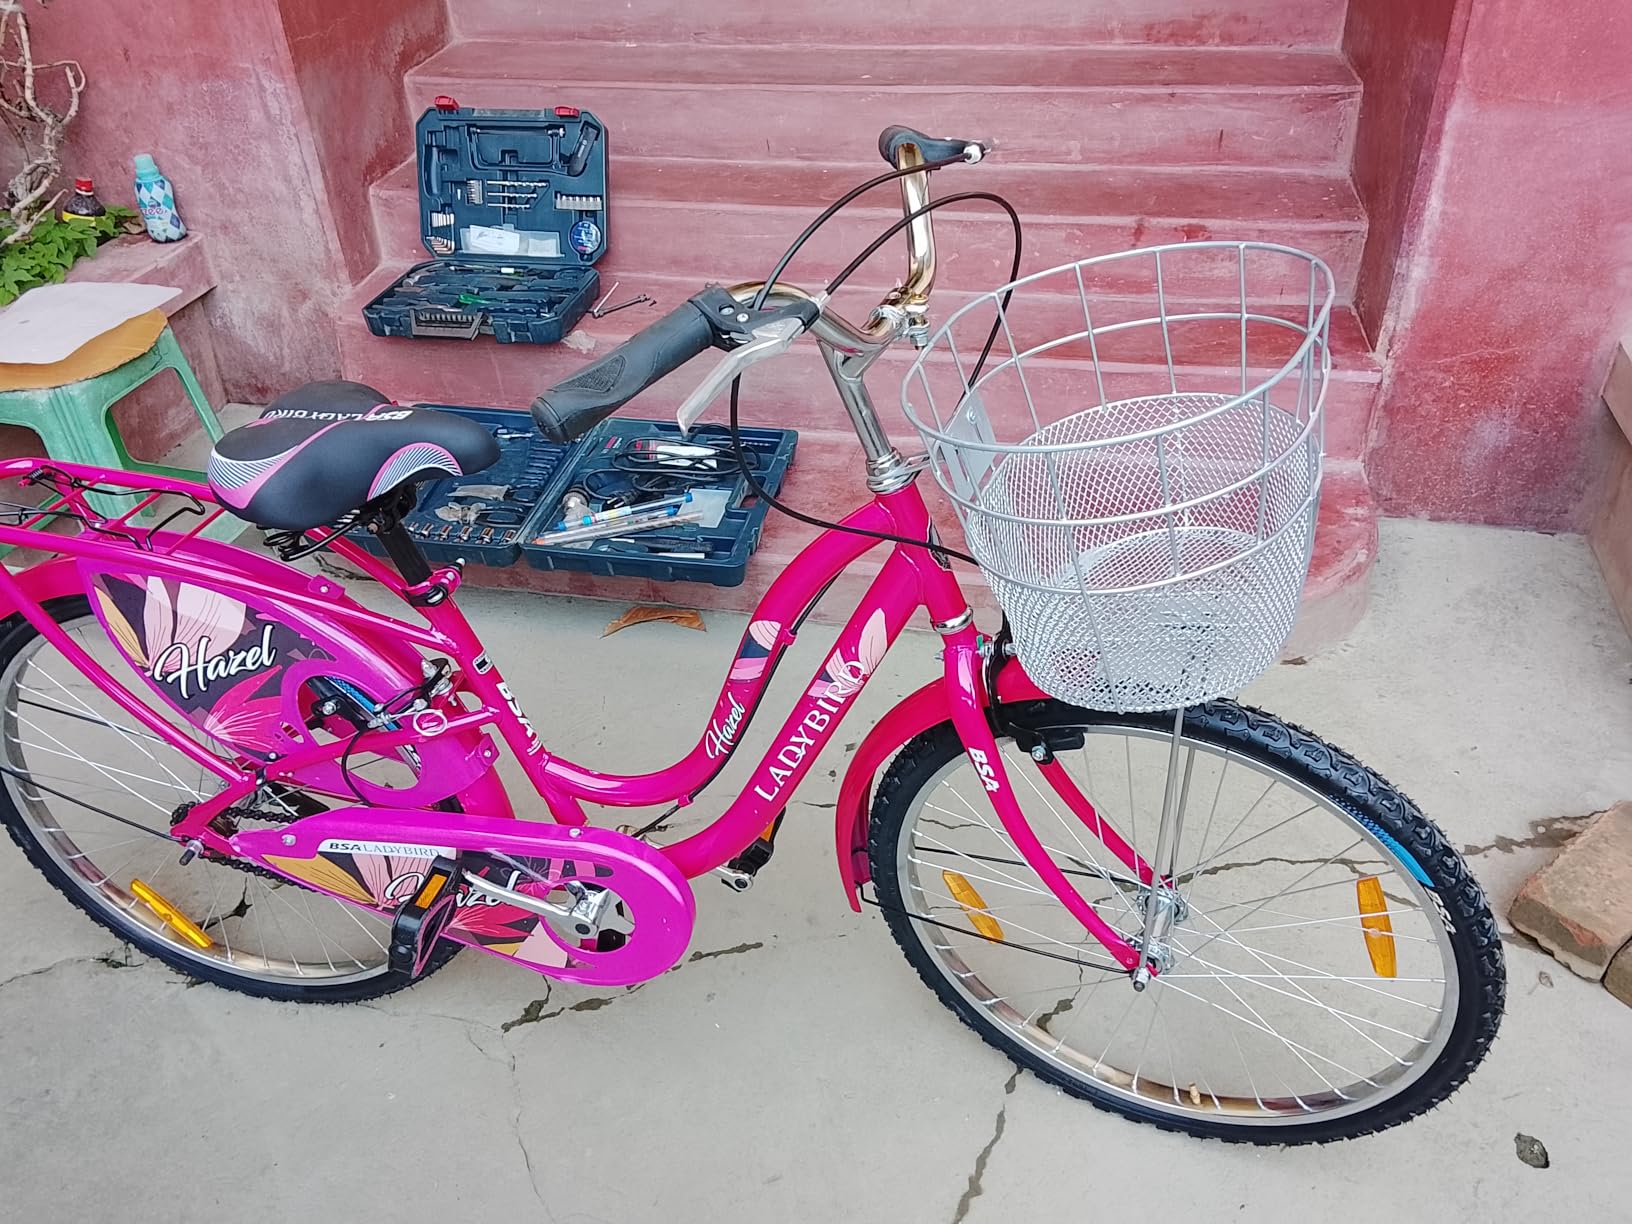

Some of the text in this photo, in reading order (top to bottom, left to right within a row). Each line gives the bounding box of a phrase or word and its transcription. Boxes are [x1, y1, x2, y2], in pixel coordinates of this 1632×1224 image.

[153, 624, 277, 699] Hazel
[705, 691, 746, 760] Hazel
[754, 661, 865, 802] LADYBIRD
[968, 747, 1000, 793] BSA
[329, 842, 362, 851] BSA
[1424, 887, 1457, 935] BSA
